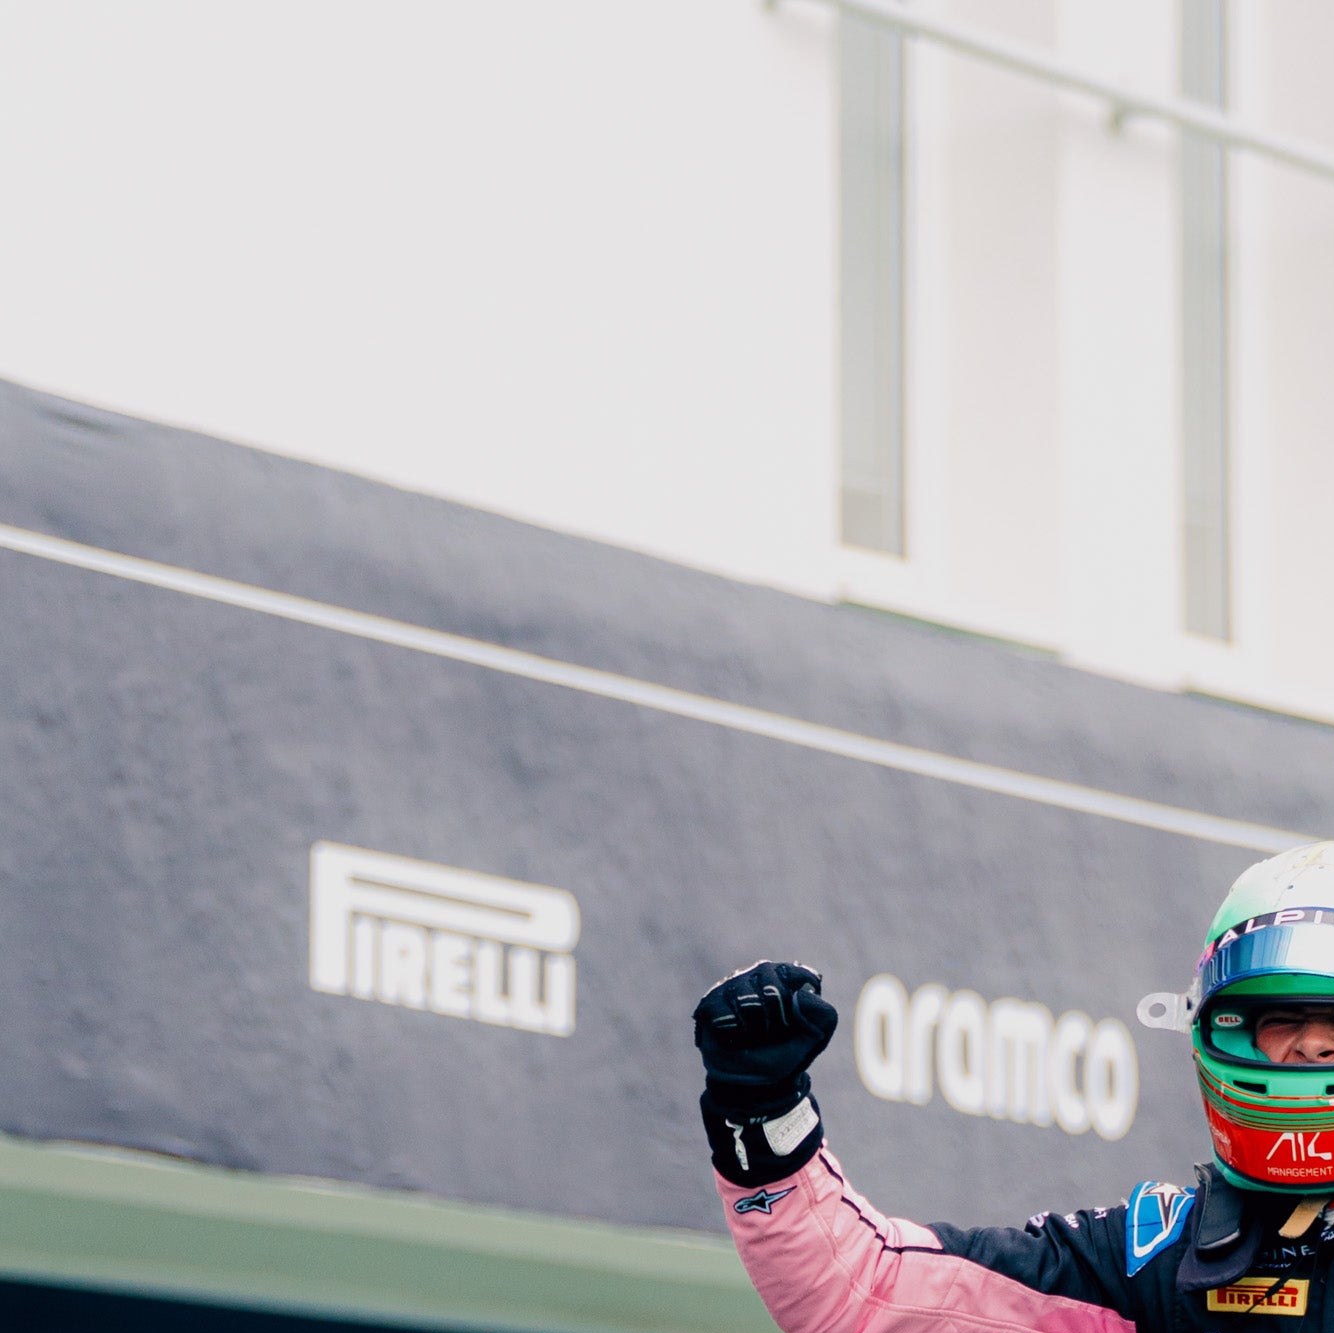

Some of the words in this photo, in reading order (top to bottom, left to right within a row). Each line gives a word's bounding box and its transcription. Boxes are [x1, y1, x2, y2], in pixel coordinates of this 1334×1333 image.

[310, 840, 580, 1038] PIRELLI
[1218, 1016, 1240, 1024] BELL
[855, 973, 1138, 1141] aramco
[1267, 1166, 1333, 1177] MANAGEMENT
[1216, 1284, 1299, 1307] PIRELLI
